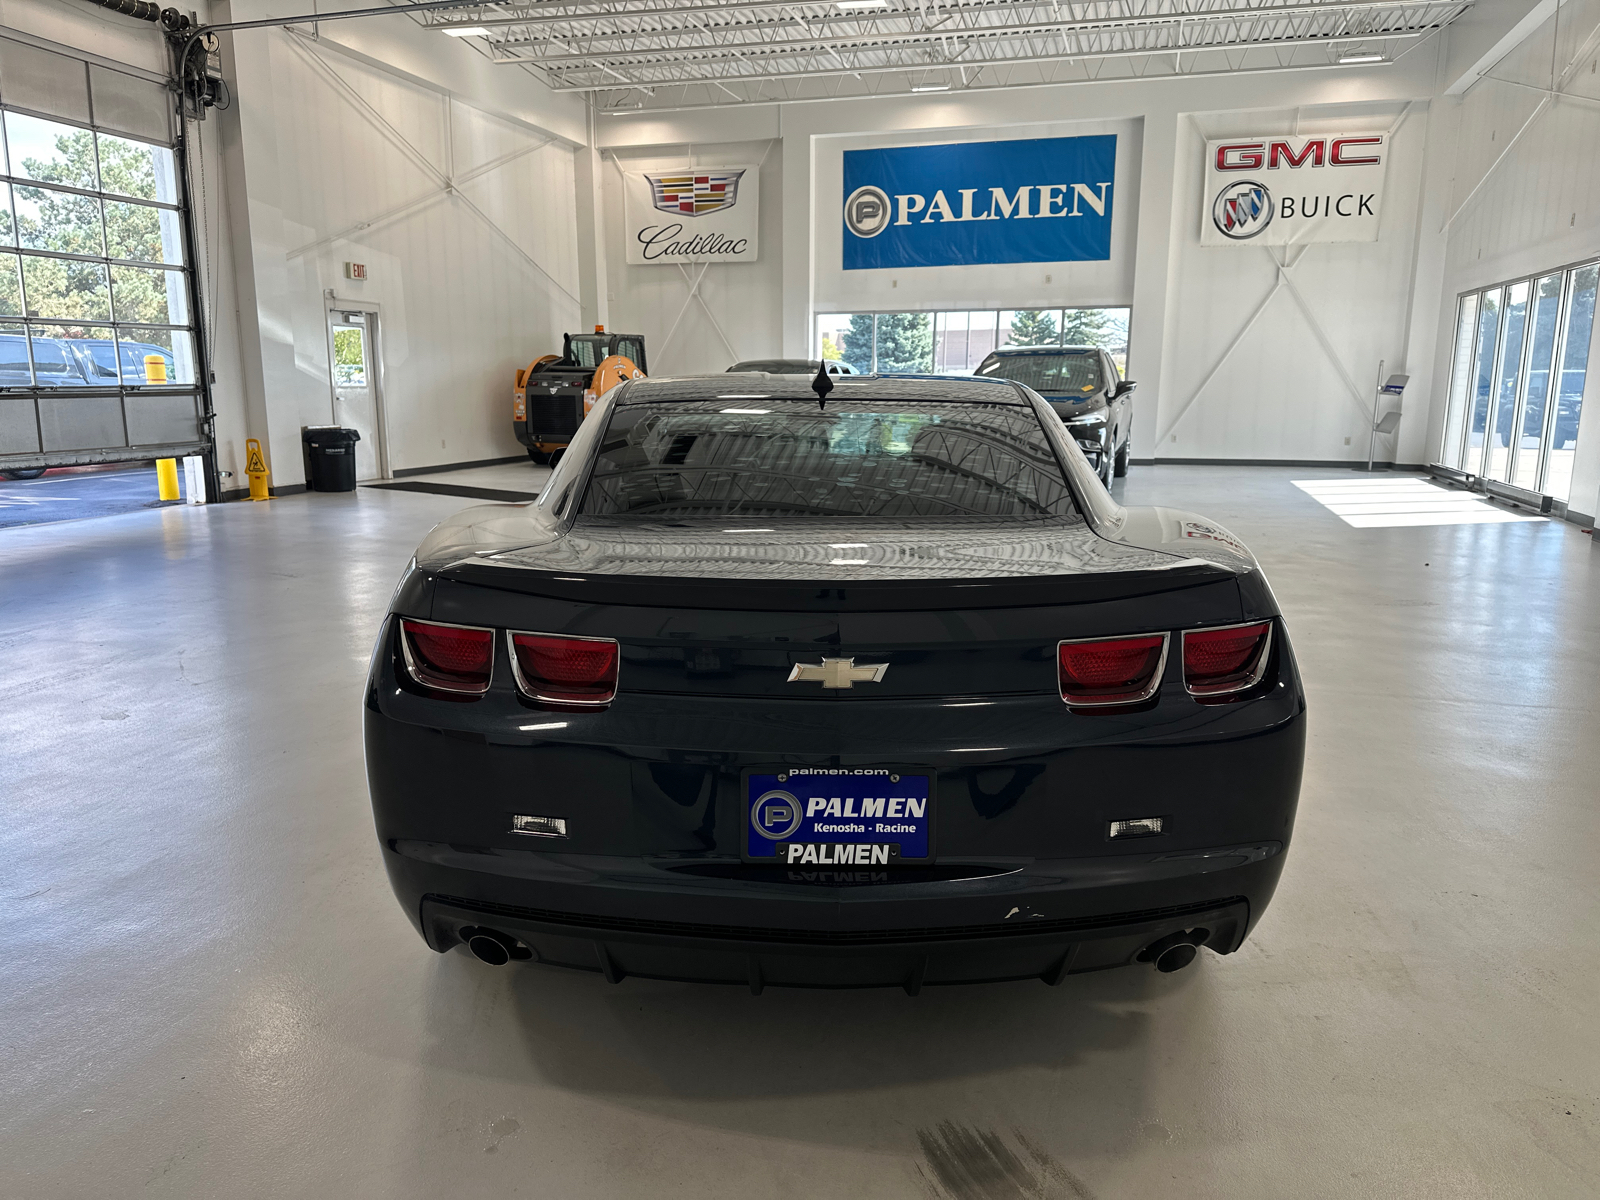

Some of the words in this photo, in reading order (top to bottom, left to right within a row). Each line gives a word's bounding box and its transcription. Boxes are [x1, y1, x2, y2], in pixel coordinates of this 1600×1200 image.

[1214, 135, 1383, 172] GMC
[893, 181, 1111, 226] PALMEN
[1280, 193, 1376, 219] BUICK
[637, 223, 748, 260] Cadillac
[352, 263, 365, 279] EXIT
[789, 768, 889, 776] palmen.com
[805, 797, 927, 818] PALMEN
[813, 822, 865, 833] Kenosha
[875, 823, 917, 833] Racine
[787, 844, 890, 865] PALMEN
